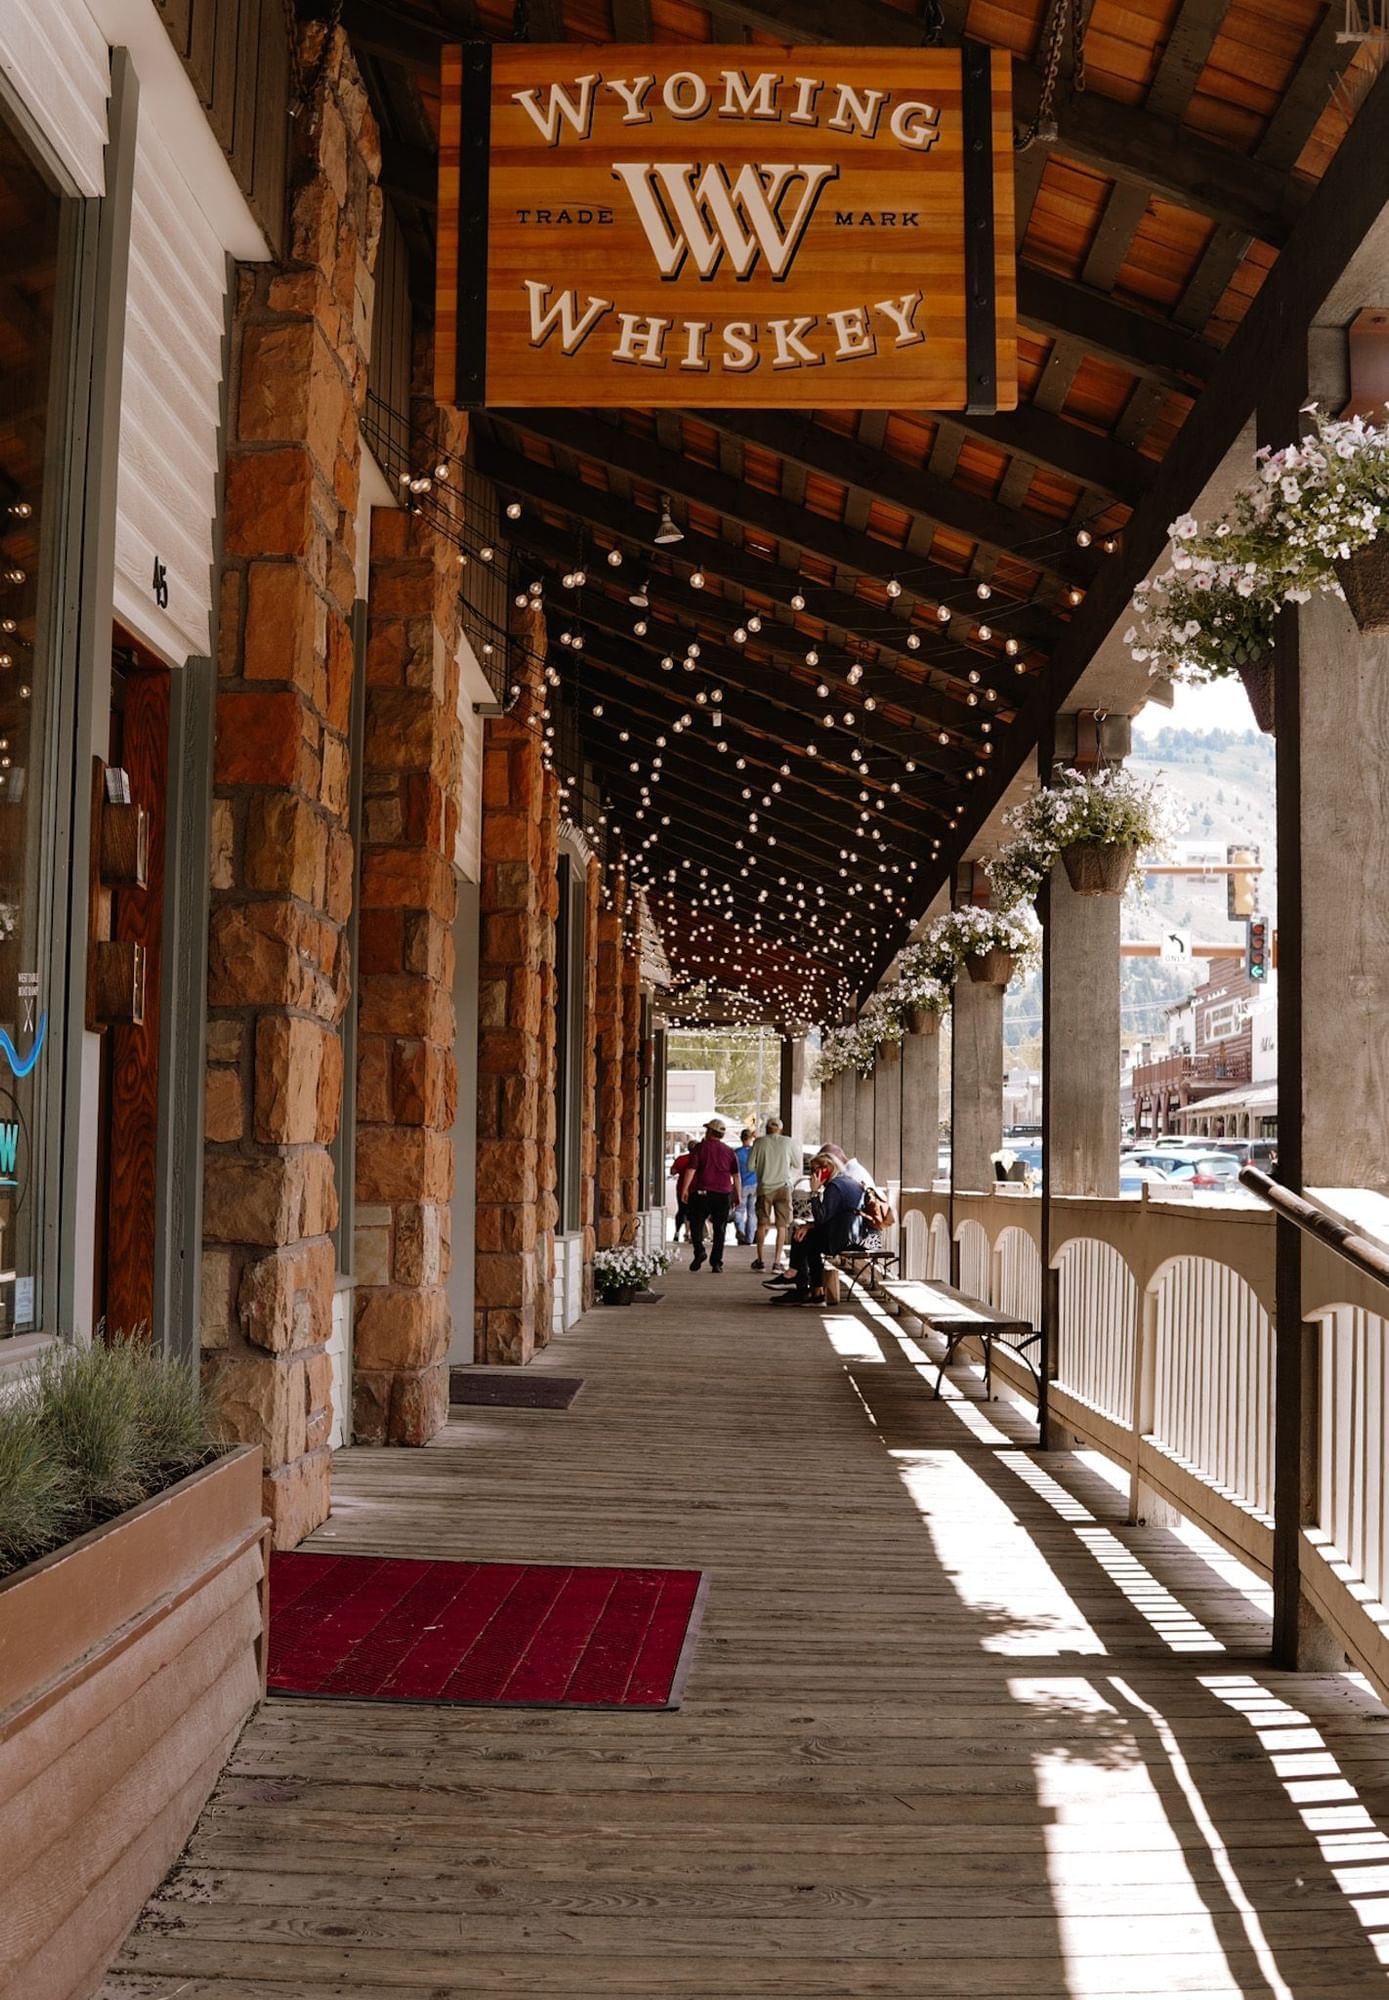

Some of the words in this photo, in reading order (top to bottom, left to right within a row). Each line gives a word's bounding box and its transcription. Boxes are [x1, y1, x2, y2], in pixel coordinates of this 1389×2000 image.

[512, 71, 940, 150] WYOMING
[516, 209, 615, 224] TRADE
[835, 211, 919, 226] MARK
[523, 279, 925, 372] WHISKEY
[152, 555, 168, 609] 45
[1165, 954, 1187, 962] ONLY
